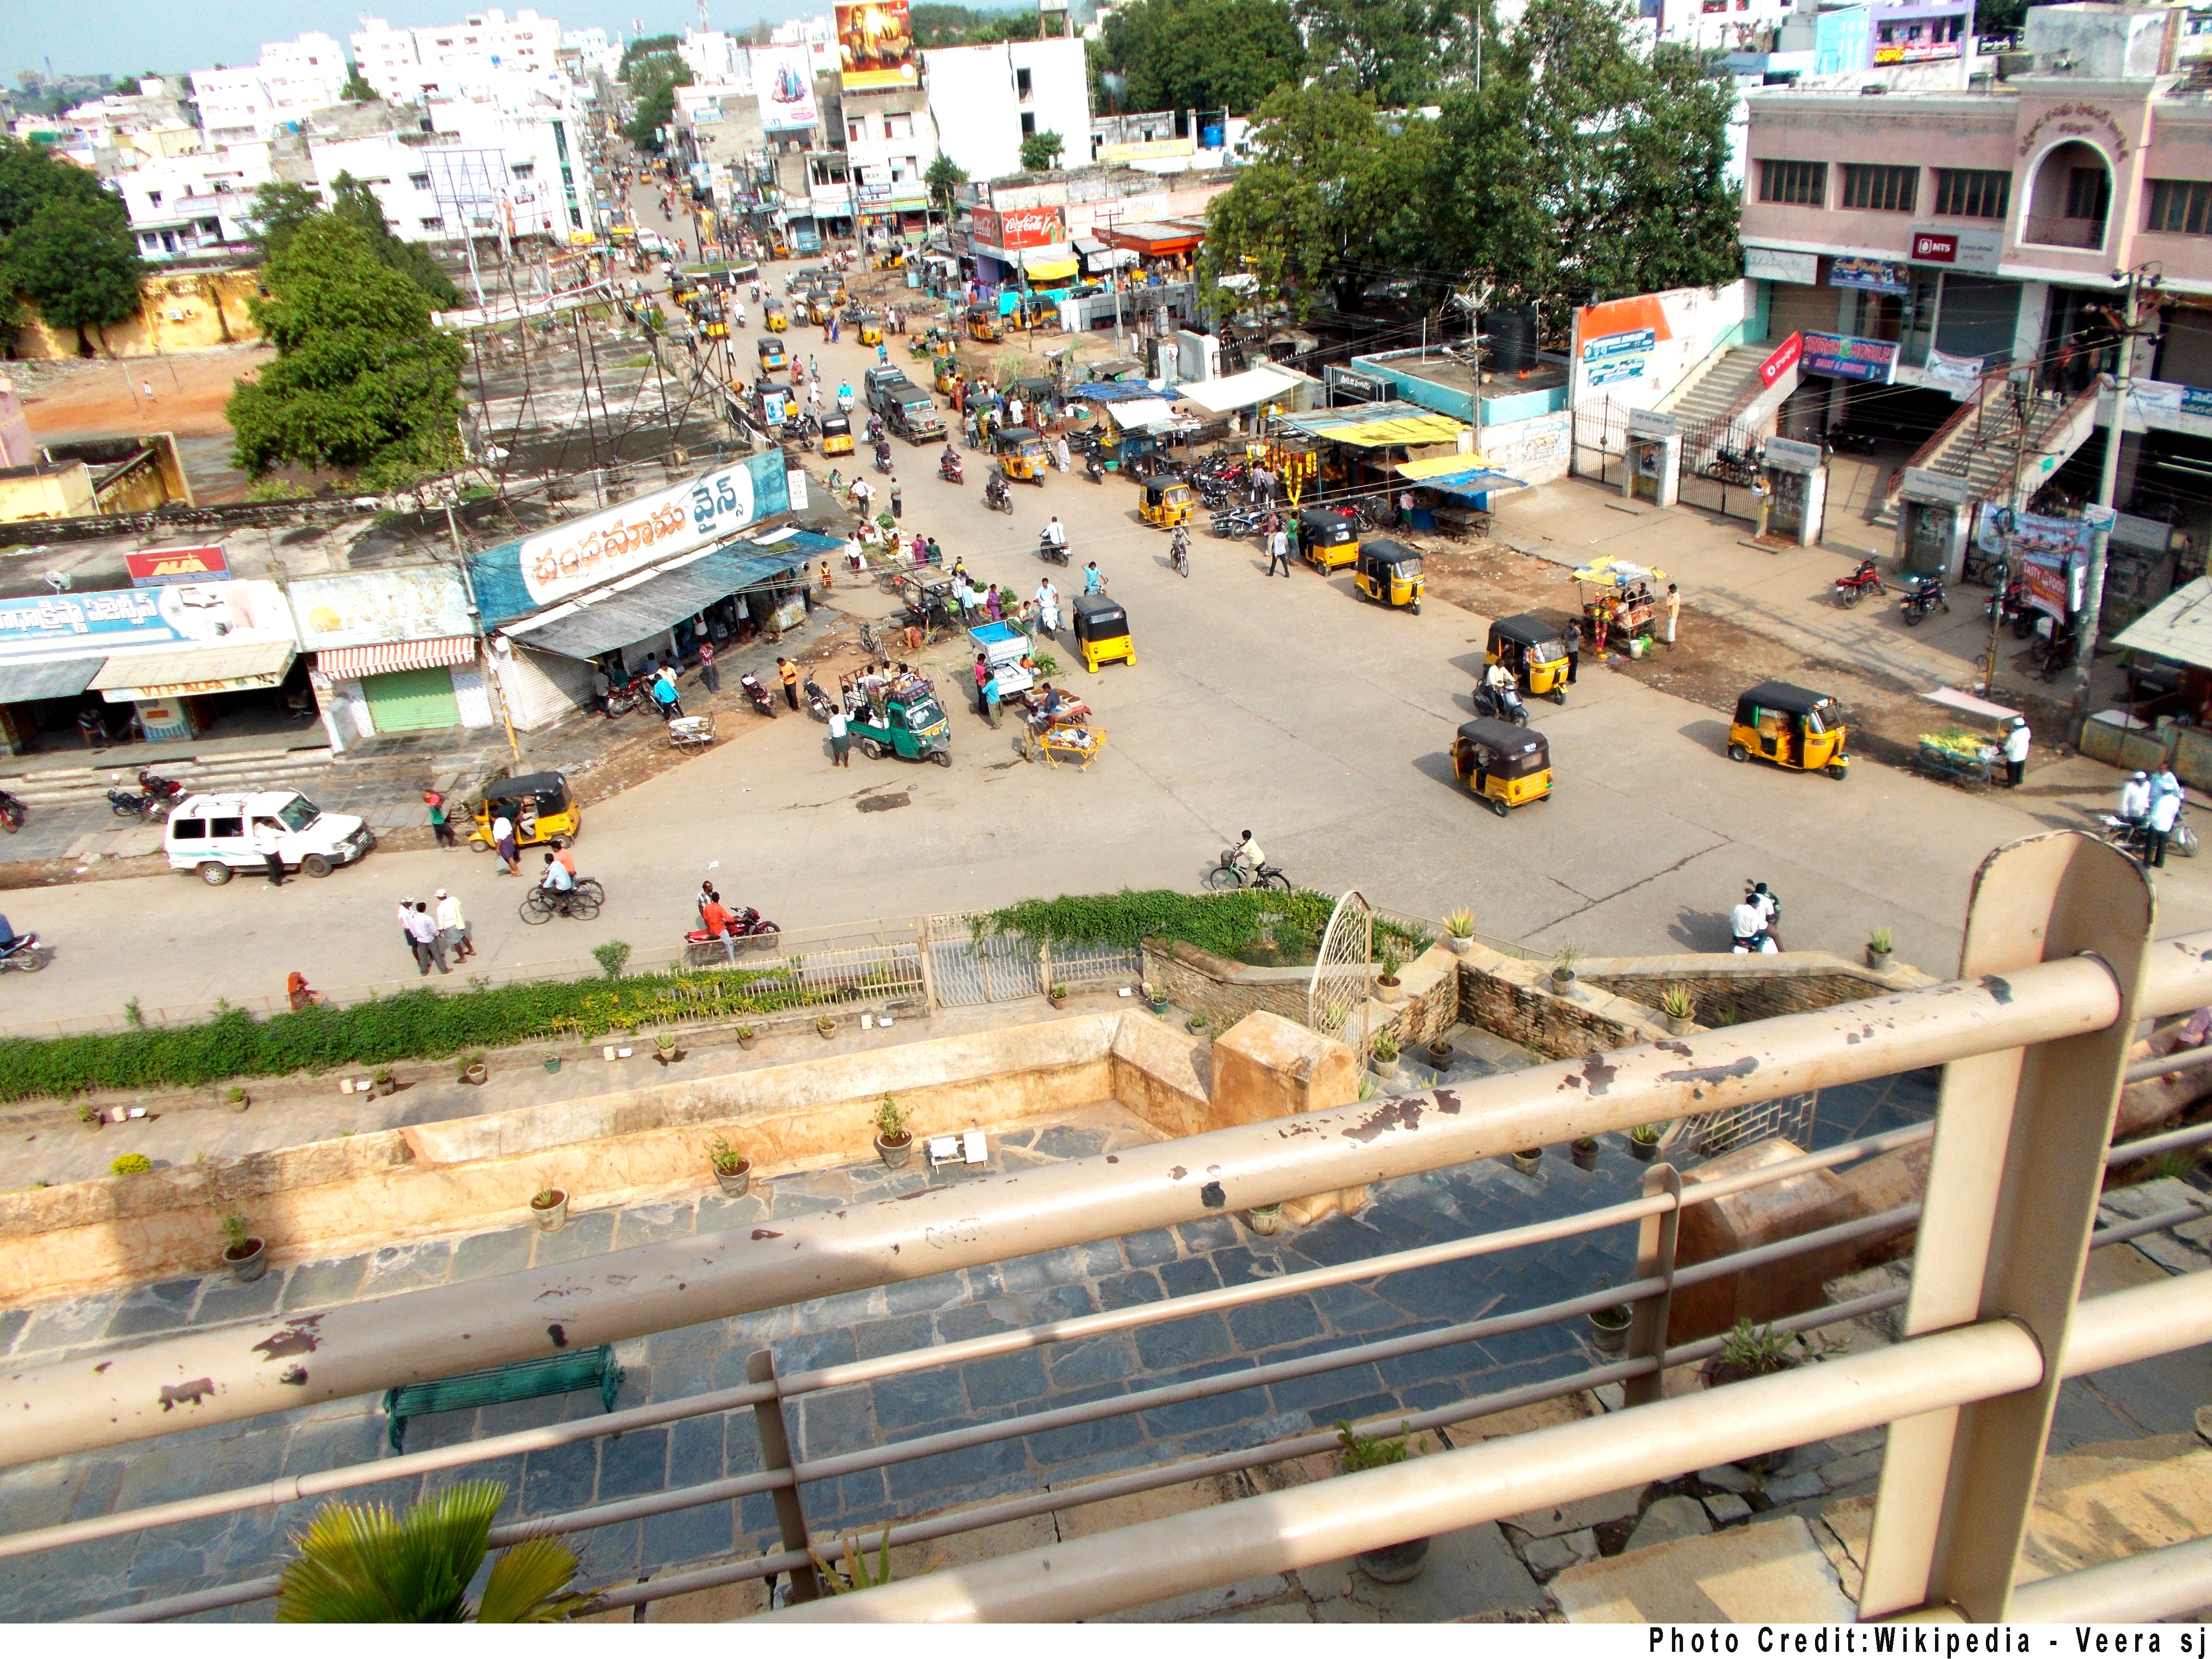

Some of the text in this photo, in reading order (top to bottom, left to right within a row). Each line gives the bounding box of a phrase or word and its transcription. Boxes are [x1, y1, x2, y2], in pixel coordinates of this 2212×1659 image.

[1932, 243, 1951, 252] MTS
[532, 475, 744, 587] చందమామ వైన్స్
[151, 559, 209, 576] ALFA
[182, 679, 227, 694] ALFA
